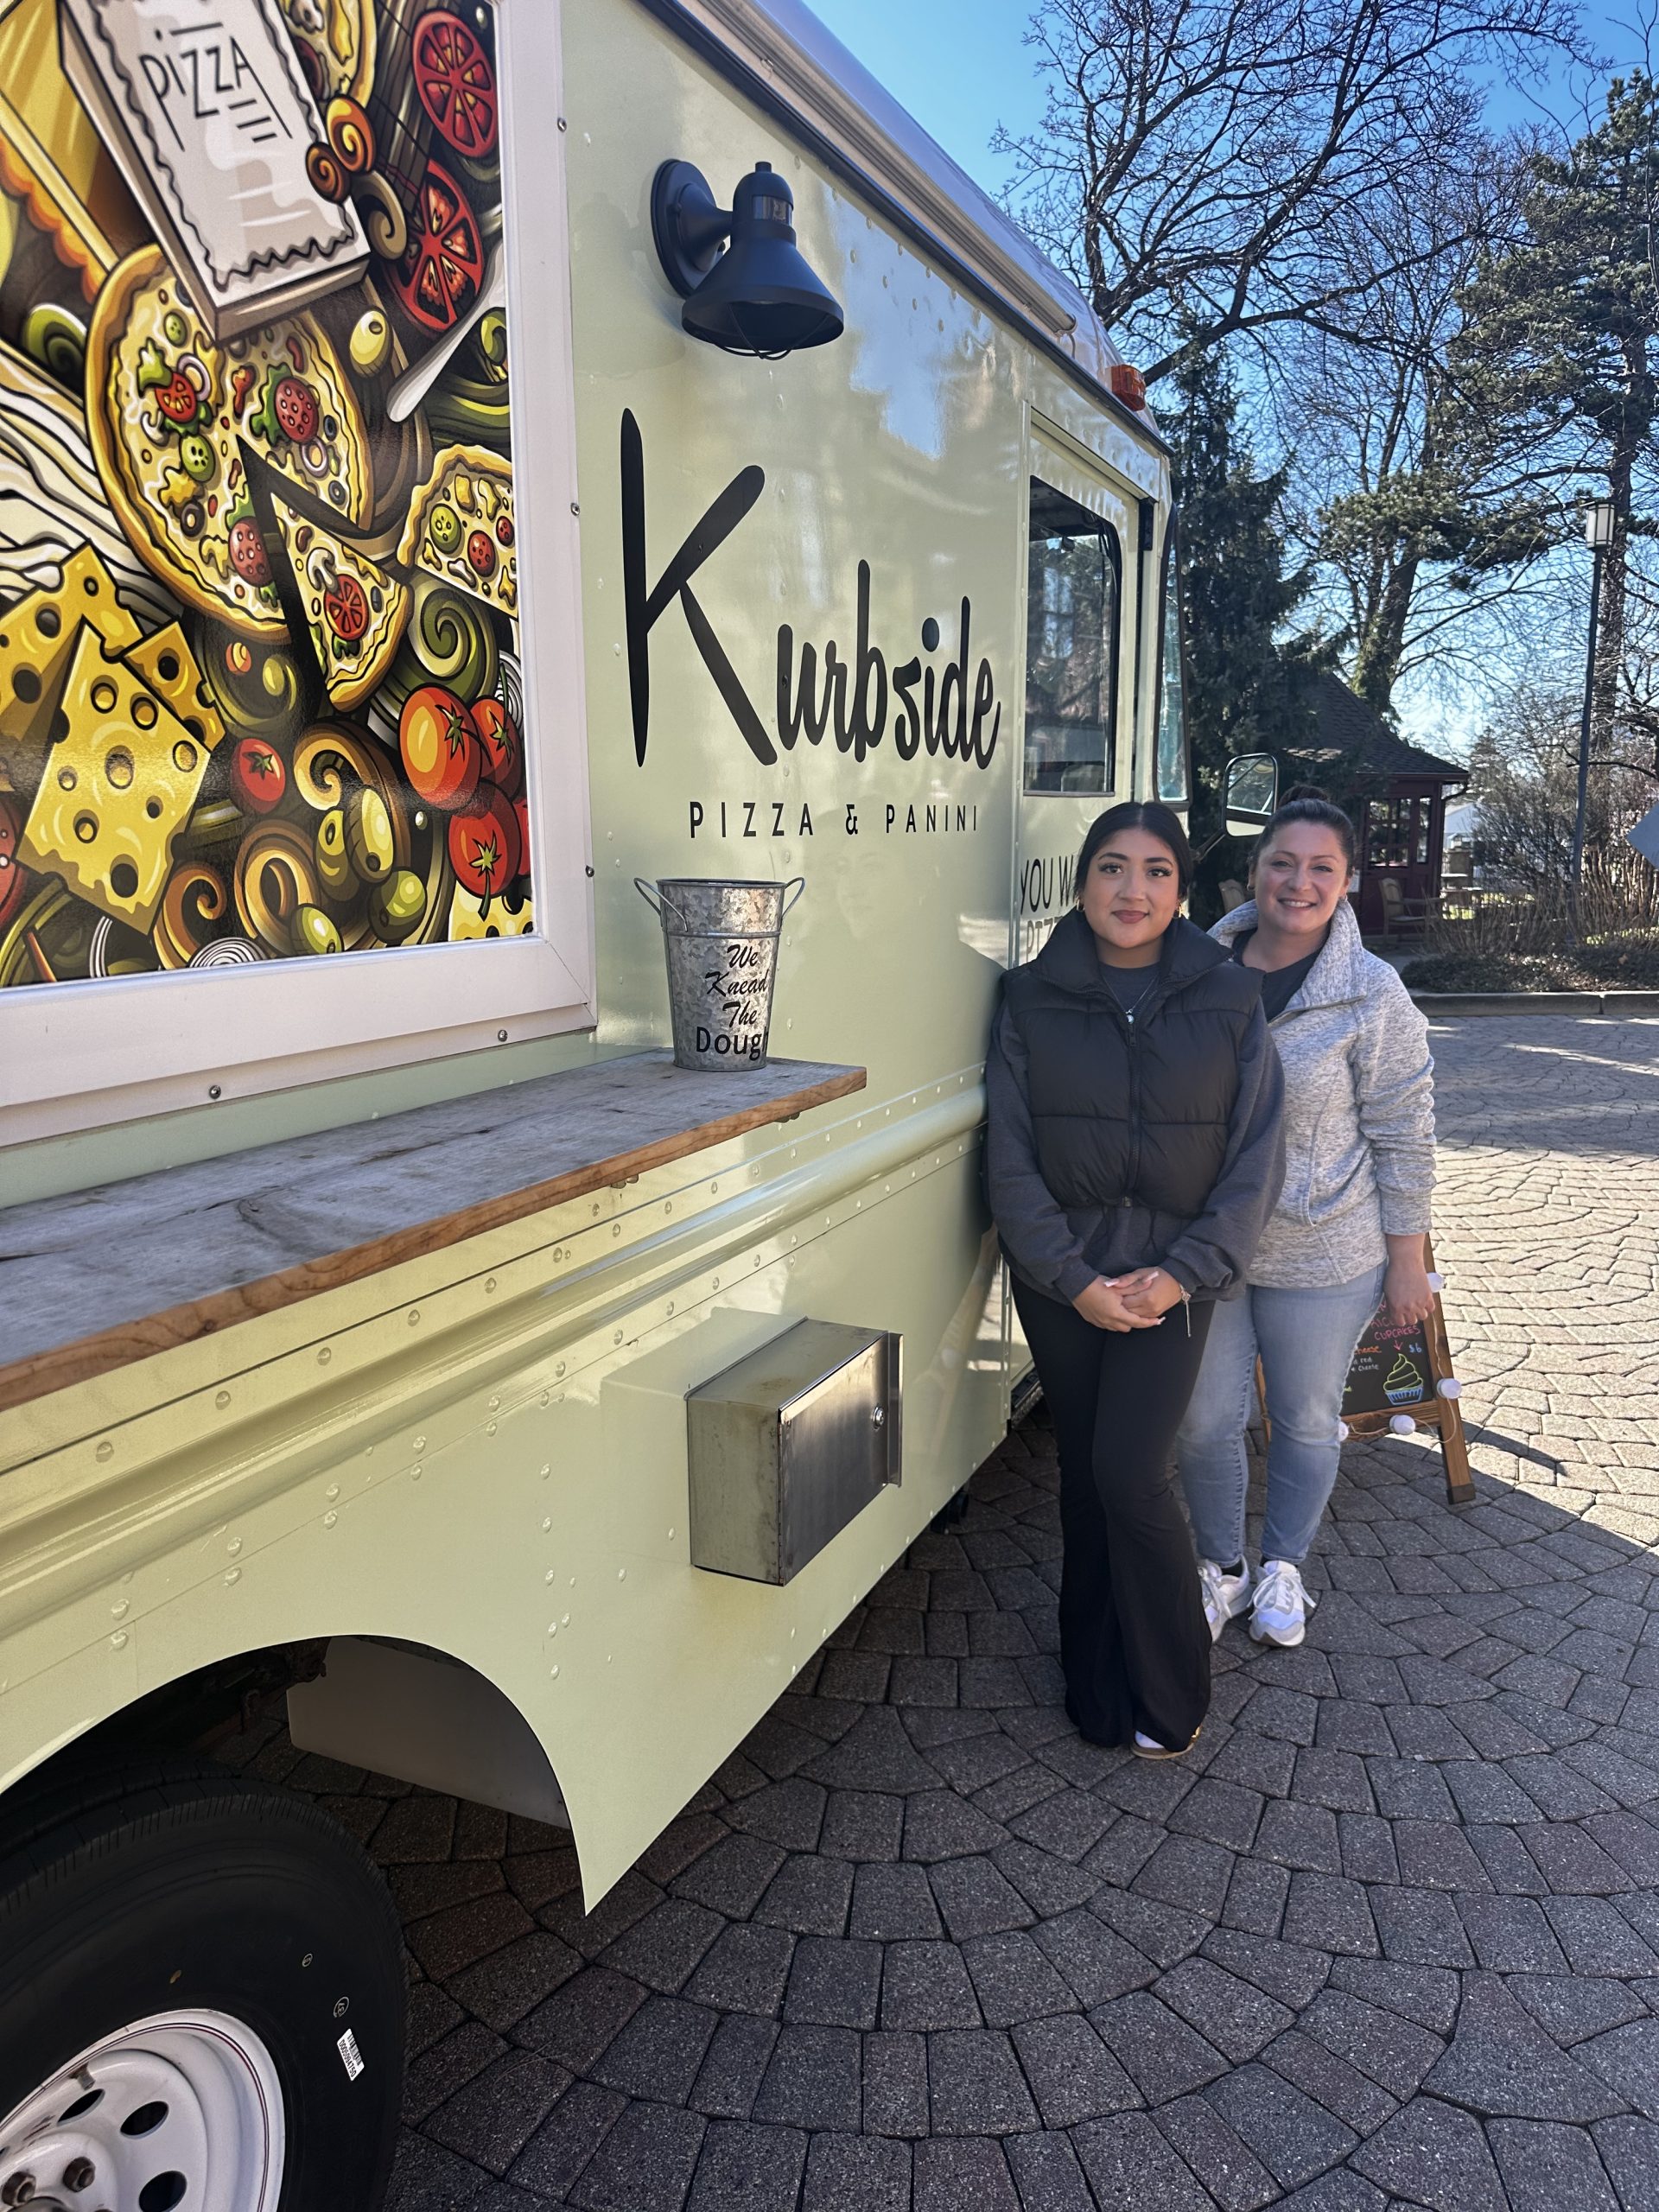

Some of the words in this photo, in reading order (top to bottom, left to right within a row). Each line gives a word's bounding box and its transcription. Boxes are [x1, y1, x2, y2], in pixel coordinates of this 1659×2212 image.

[620, 408, 1001, 770] Kurbside
[690, 801, 814, 838] PIZZA
[845, 804, 858, 835] &
[886, 804, 976, 834] PANINI
[1020, 857, 1053, 916] YOU
[727, 944, 758, 968] We
[704, 969, 768, 997] Knead
[722, 1001, 758, 1027] The
[1374, 1325, 1421, 1340] CUPCAKES
